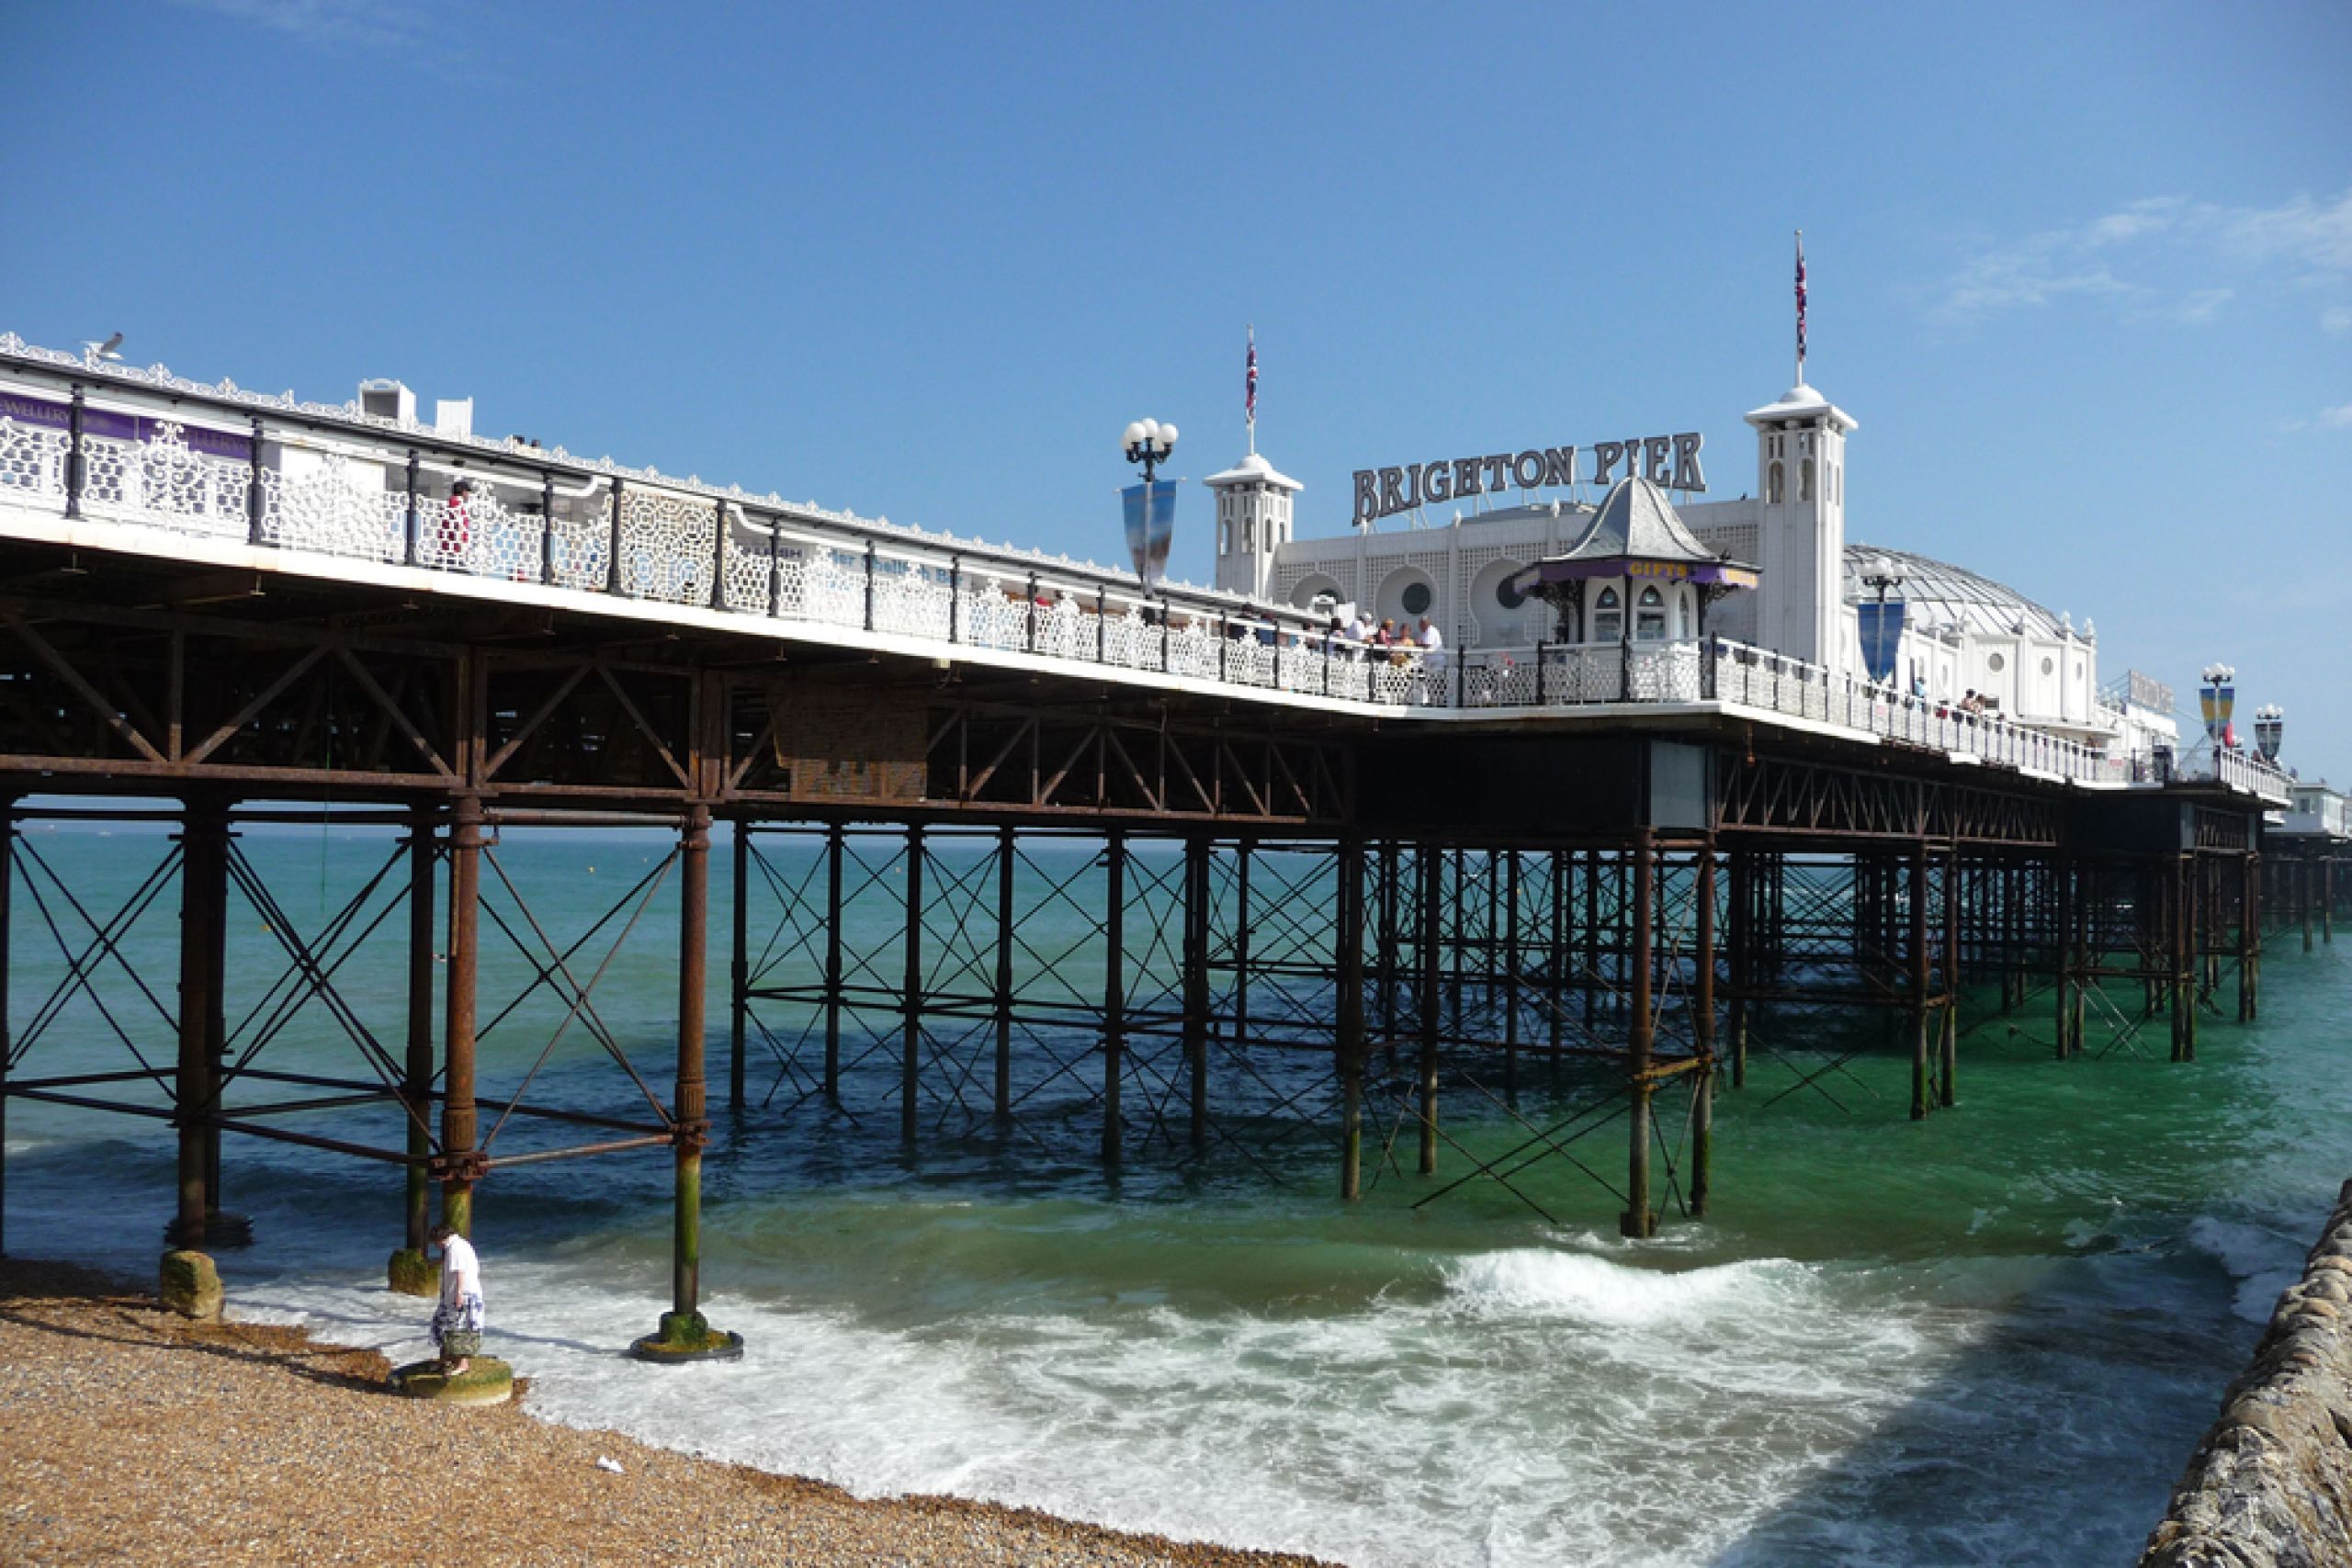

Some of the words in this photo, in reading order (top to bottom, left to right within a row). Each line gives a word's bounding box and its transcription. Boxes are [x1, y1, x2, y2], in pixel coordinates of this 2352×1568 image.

[1351, 446, 1577, 526] BRIGHTON
[1594, 432, 1707, 493] PIER
[1630, 561, 1688, 578] GIFTS
